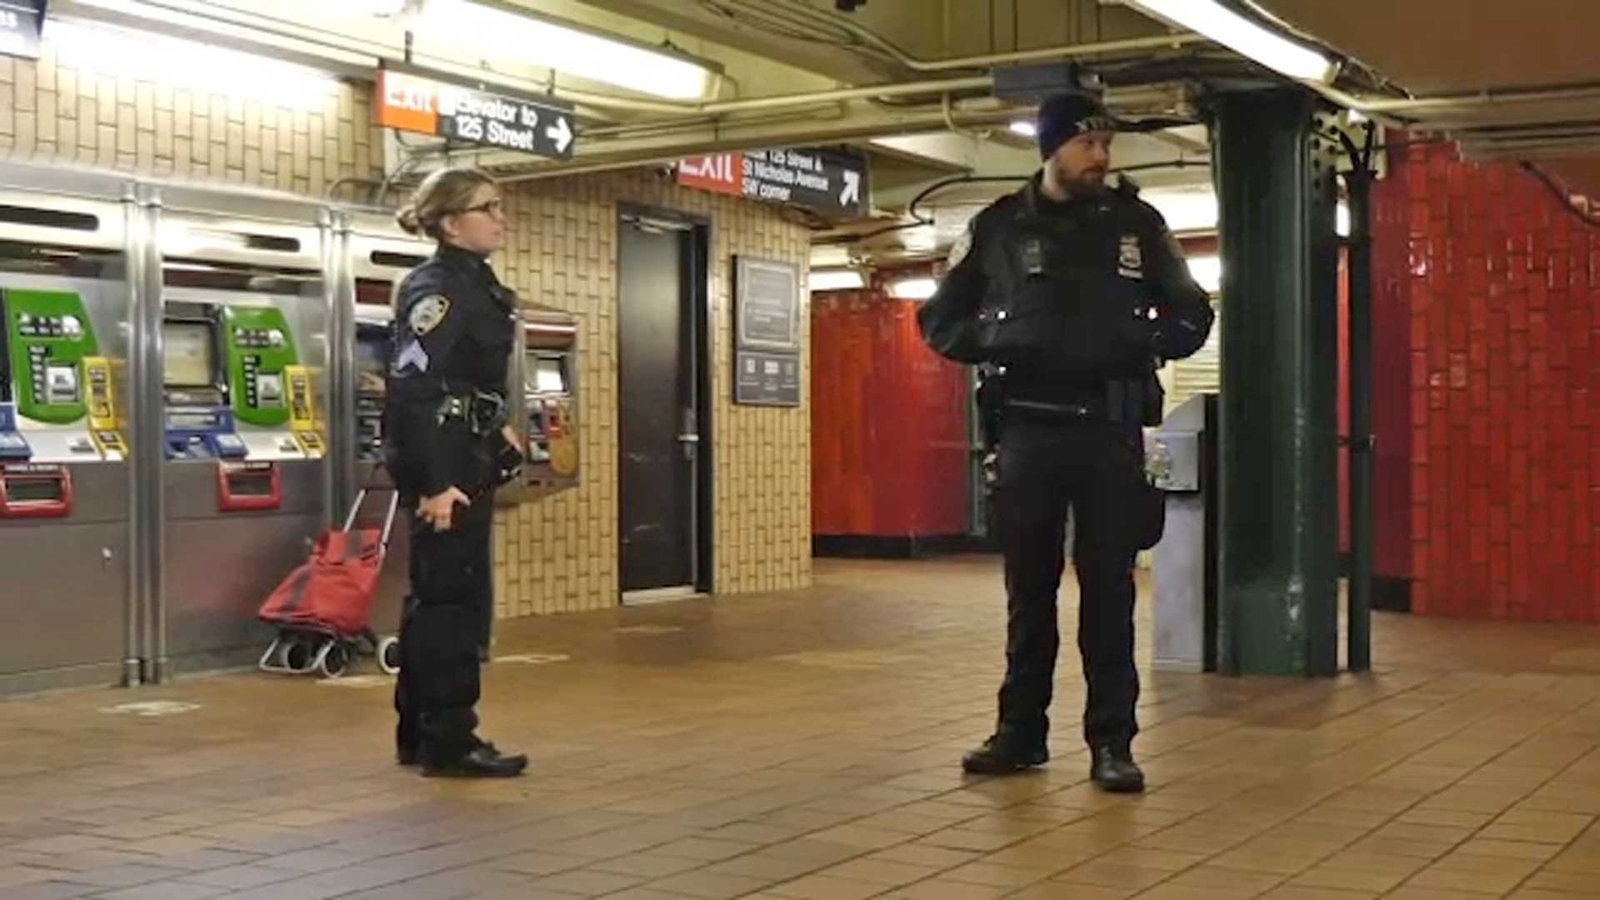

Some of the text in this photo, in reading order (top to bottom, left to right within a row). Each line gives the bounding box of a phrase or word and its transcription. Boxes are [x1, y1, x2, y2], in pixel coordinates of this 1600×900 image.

[521, 105, 538, 128] to
[456, 114, 534, 151] 125 Street
[760, 184, 791, 201] corner
